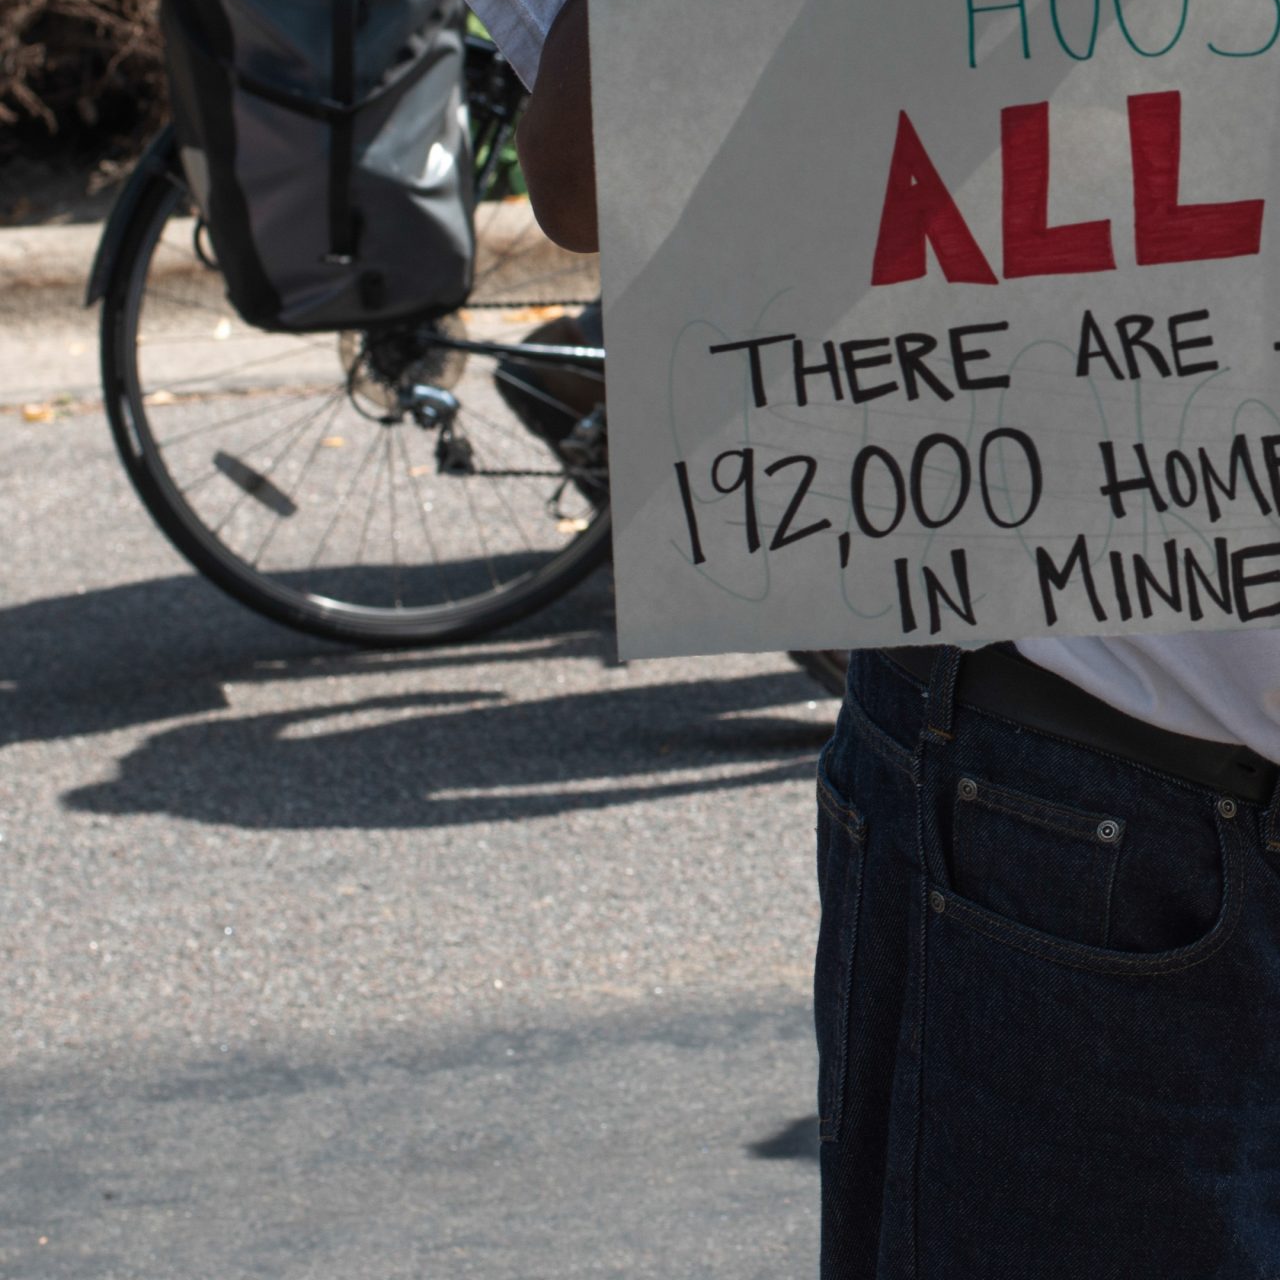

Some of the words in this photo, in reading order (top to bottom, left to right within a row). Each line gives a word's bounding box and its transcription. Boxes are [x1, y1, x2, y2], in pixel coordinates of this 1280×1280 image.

[708, 320, 1011, 409] THERE
[1074, 308, 1220, 381] ARE
[674, 427, 1044, 569] 192,000
[894, 548, 977, 634] IN
